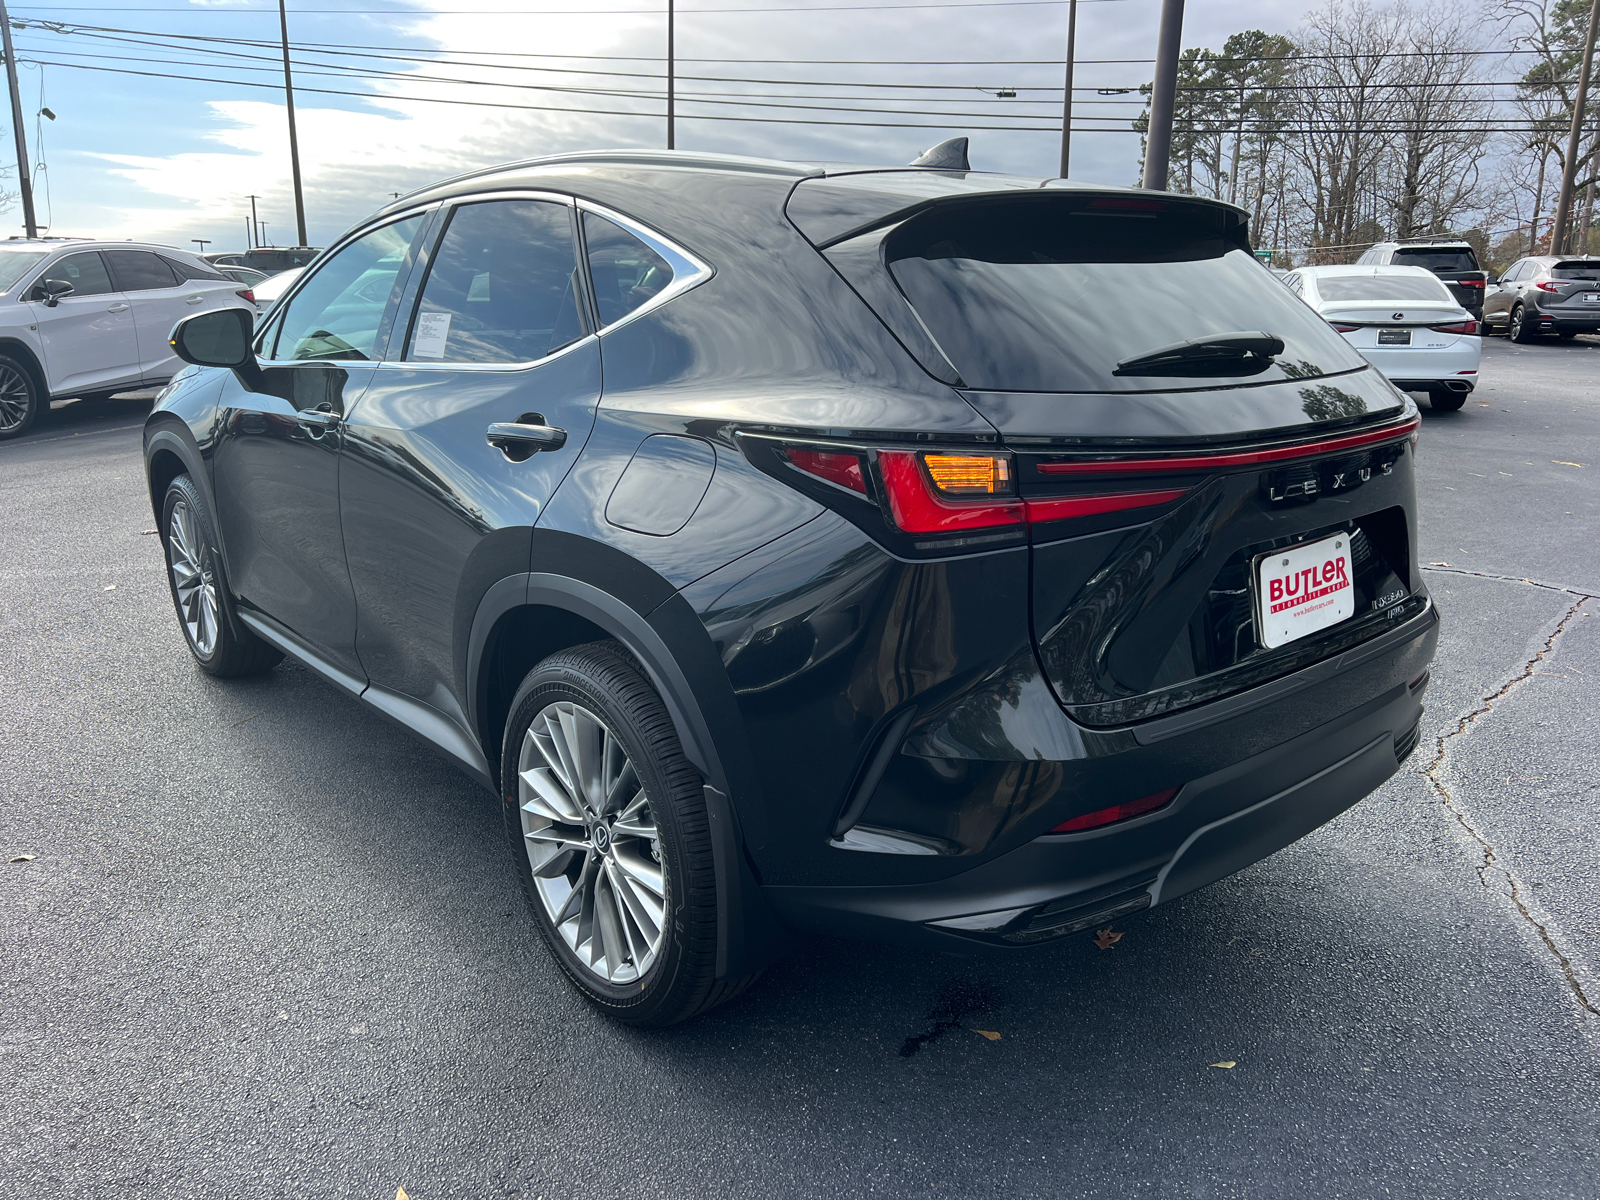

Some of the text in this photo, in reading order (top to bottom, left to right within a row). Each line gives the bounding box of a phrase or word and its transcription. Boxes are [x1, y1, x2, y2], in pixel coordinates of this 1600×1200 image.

[1270, 462, 1392, 501] LEXUS
[1271, 580, 1348, 613] AUTOMOTIVE GROUP
[563, 670, 610, 707] BRIDGESTONE
